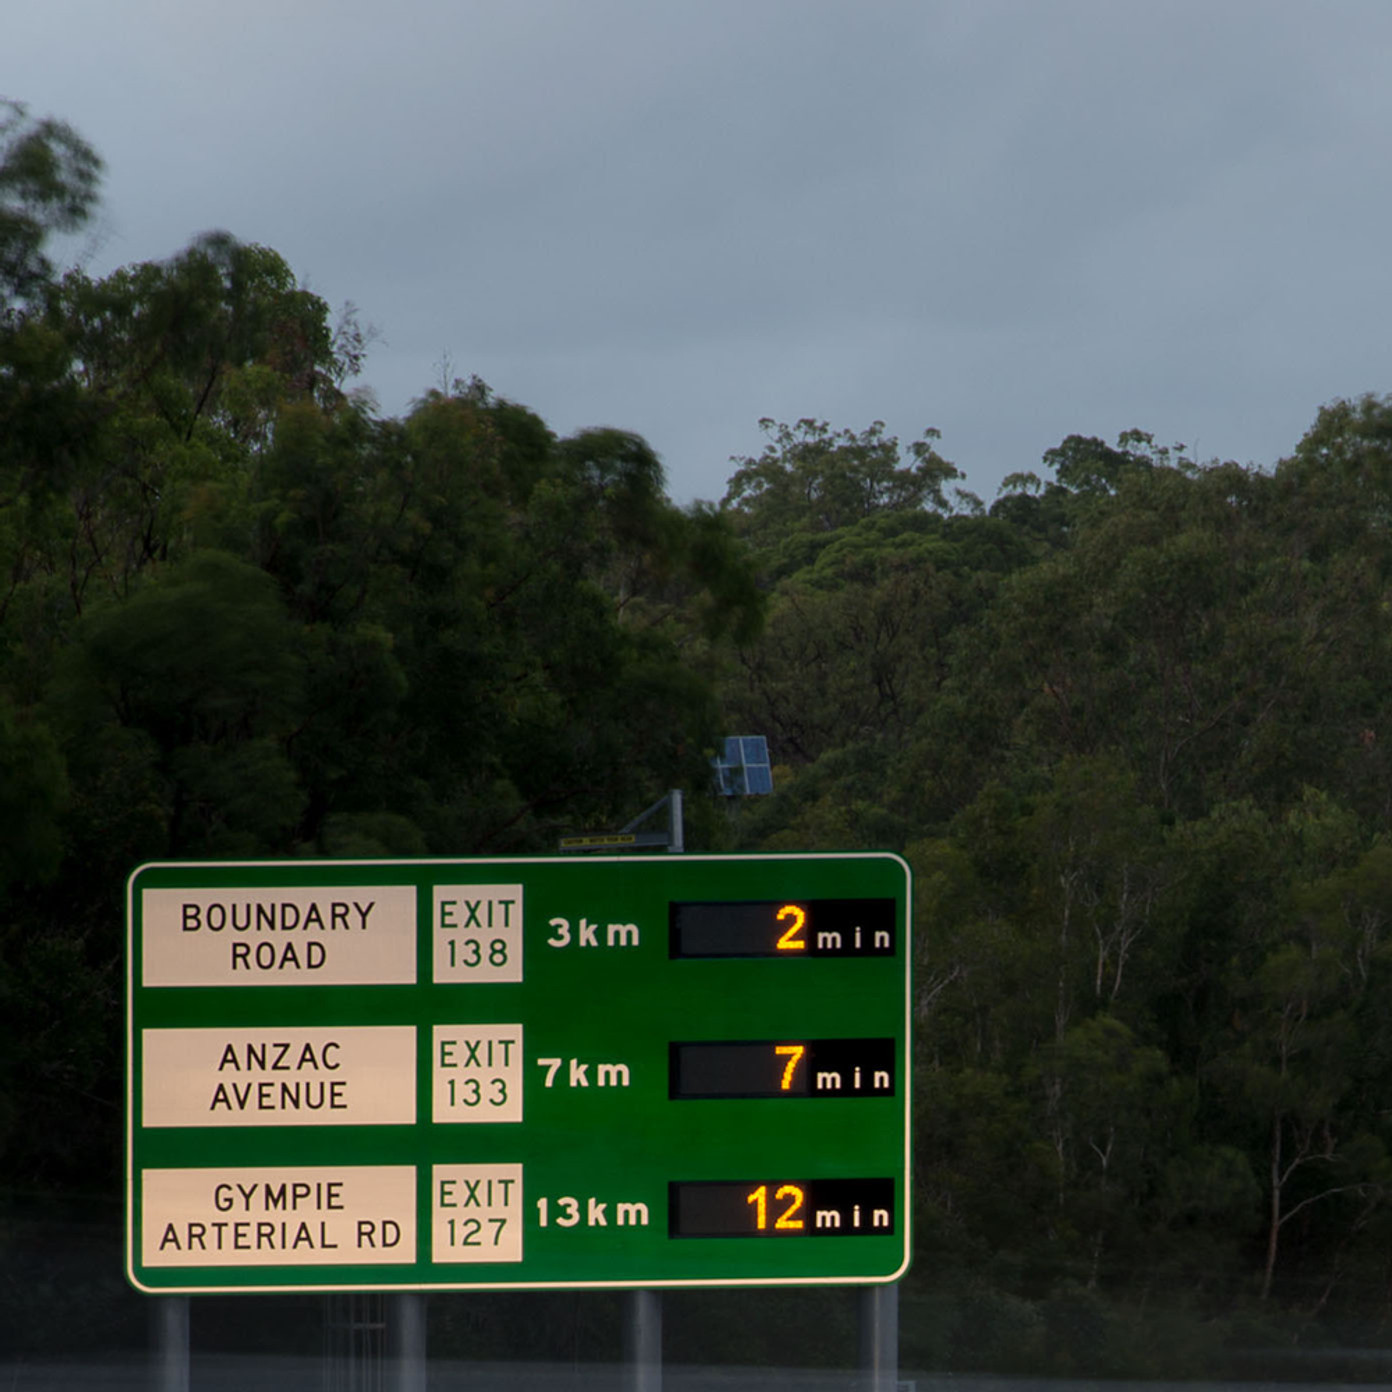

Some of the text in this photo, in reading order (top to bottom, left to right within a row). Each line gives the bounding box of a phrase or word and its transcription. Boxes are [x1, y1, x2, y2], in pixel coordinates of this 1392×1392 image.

[181, 900, 376, 933] BOUNDARY
[439, 898, 517, 930] EXIT
[775, 904, 891, 951] 2 min
[546, 916, 640, 949] 3km
[231, 940, 327, 972] ROAD
[447, 937, 509, 969] 138
[217, 1041, 341, 1073] ANZAC
[439, 1038, 517, 1069] EXIT
[774, 1044, 890, 1091] 7 min
[536, 1056, 631, 1089] 7km
[208, 1080, 349, 1112] AVENUE
[446, 1076, 509, 1108] 133
[213, 1181, 346, 1213] GYMPIE
[438, 1178, 517, 1209] EXIT
[746, 1183, 890, 1231] 12 min
[535, 1195, 650, 1228] 13km
[158, 1219, 402, 1252] ARTERIAL RD
[446, 1217, 508, 1248] 127
